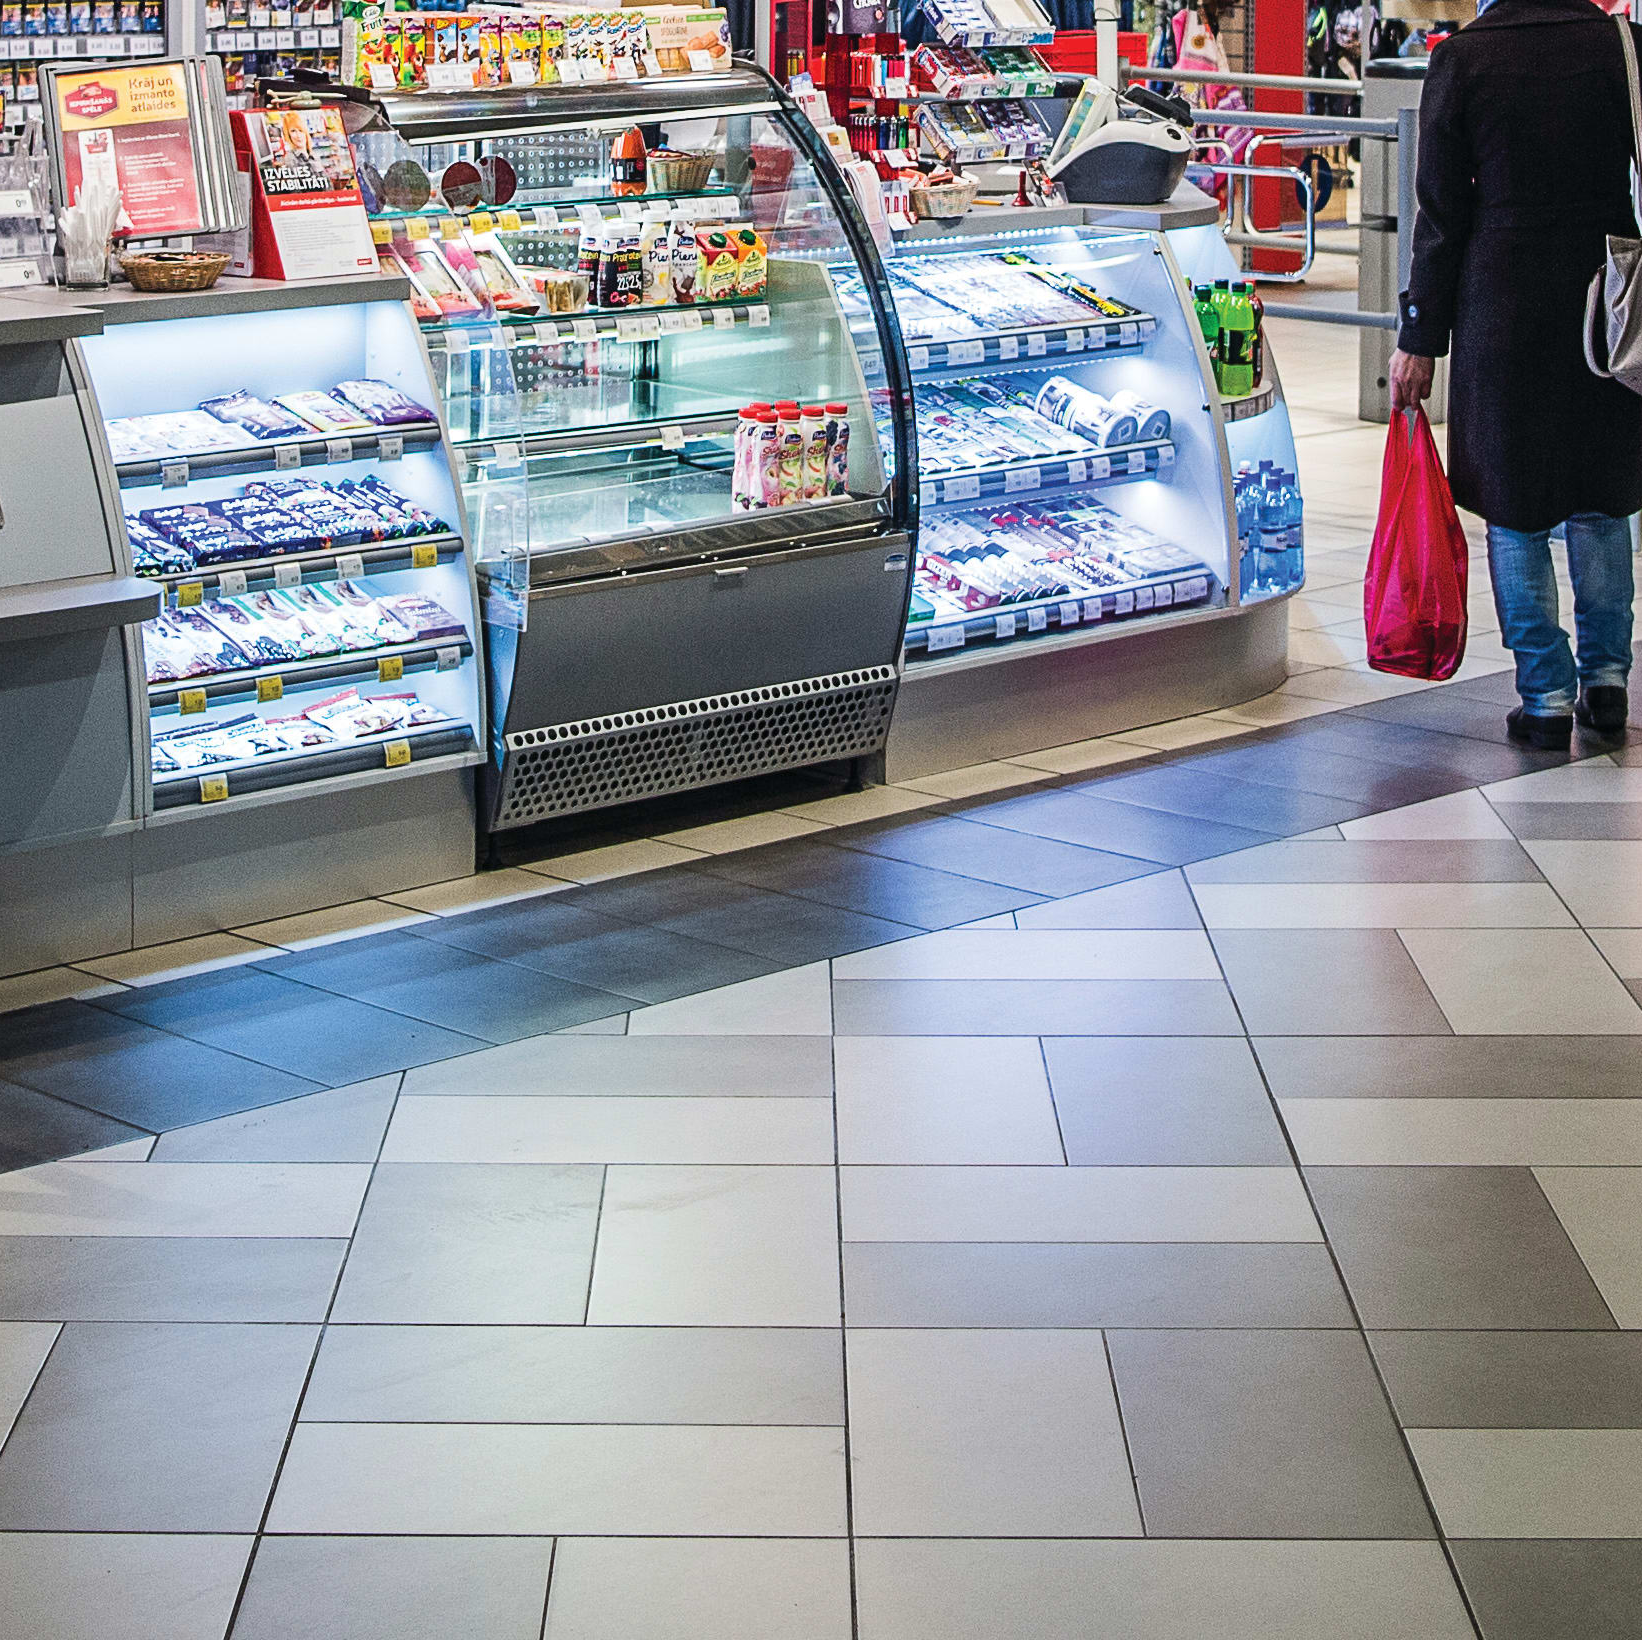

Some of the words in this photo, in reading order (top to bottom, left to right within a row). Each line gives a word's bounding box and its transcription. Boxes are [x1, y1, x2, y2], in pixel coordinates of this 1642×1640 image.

[128, 76, 156, 91] Krāj
[158, 76, 173, 87] un
[130, 89, 175, 102] izmanto
[131, 101, 177, 113] atlaides
[264, 165, 311, 180] IZVĒLIES
[267, 175, 329, 192] STABILITĀTI
